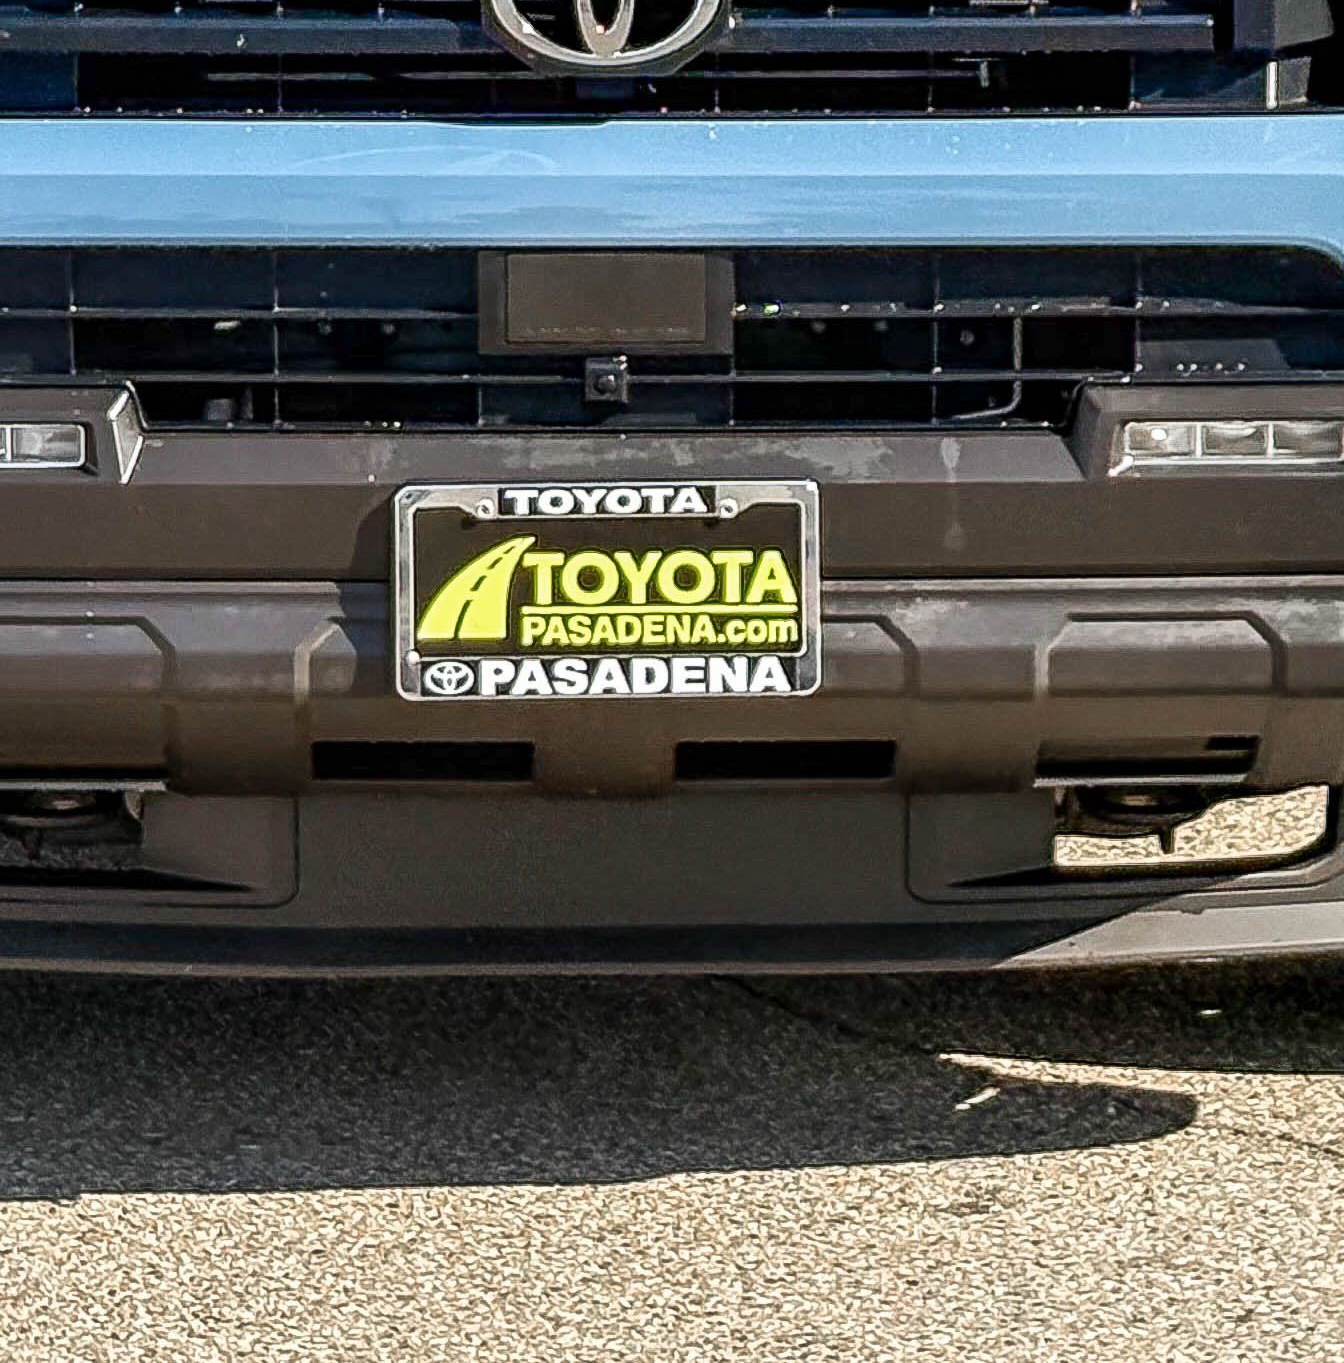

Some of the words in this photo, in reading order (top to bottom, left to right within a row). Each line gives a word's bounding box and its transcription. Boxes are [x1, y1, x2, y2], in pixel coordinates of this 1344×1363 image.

[504, 487, 708, 515] TOYOTA
[523, 550, 797, 605] TOYOTA
[522, 614, 798, 646] PASADENA.com
[481, 658, 792, 695] PASADENA
